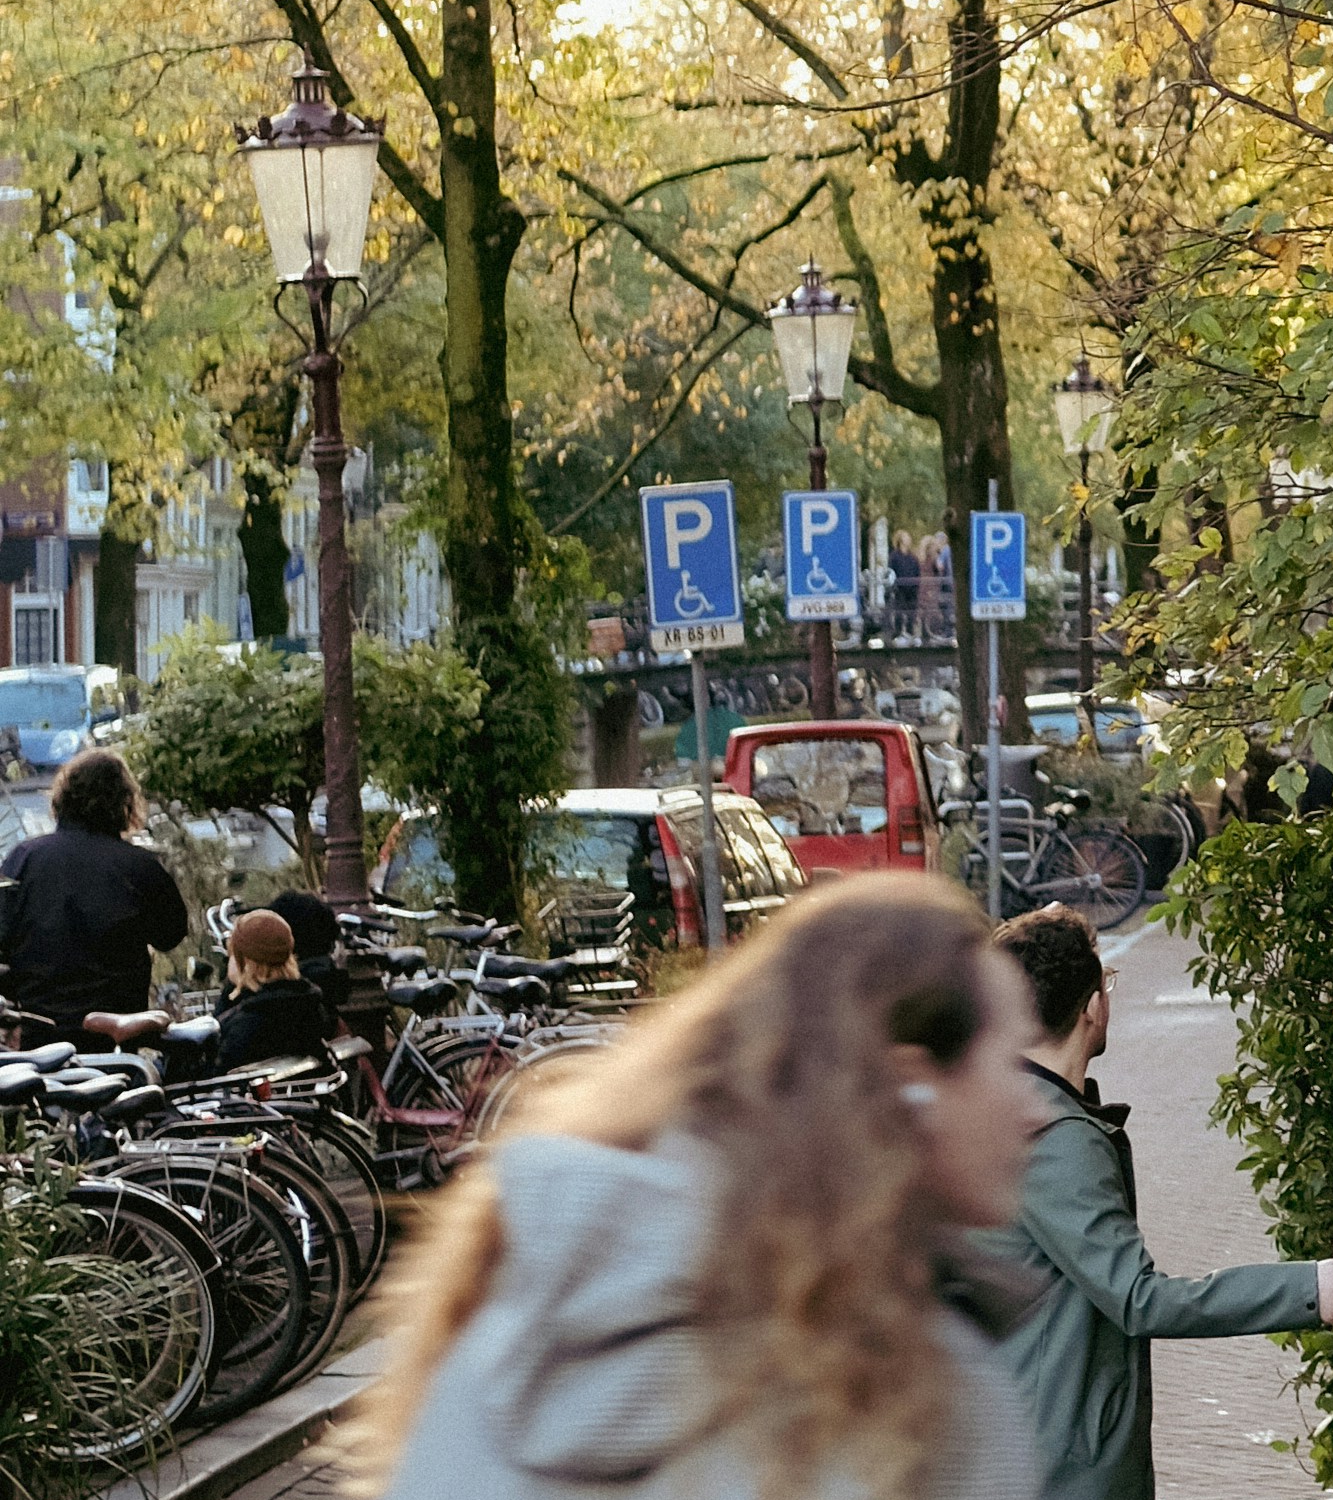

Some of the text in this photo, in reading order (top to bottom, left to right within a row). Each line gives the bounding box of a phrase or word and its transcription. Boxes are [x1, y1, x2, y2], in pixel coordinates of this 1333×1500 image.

[663, 500, 713, 569] P
[801, 500, 839, 555] P
[985, 520, 1013, 565] P
